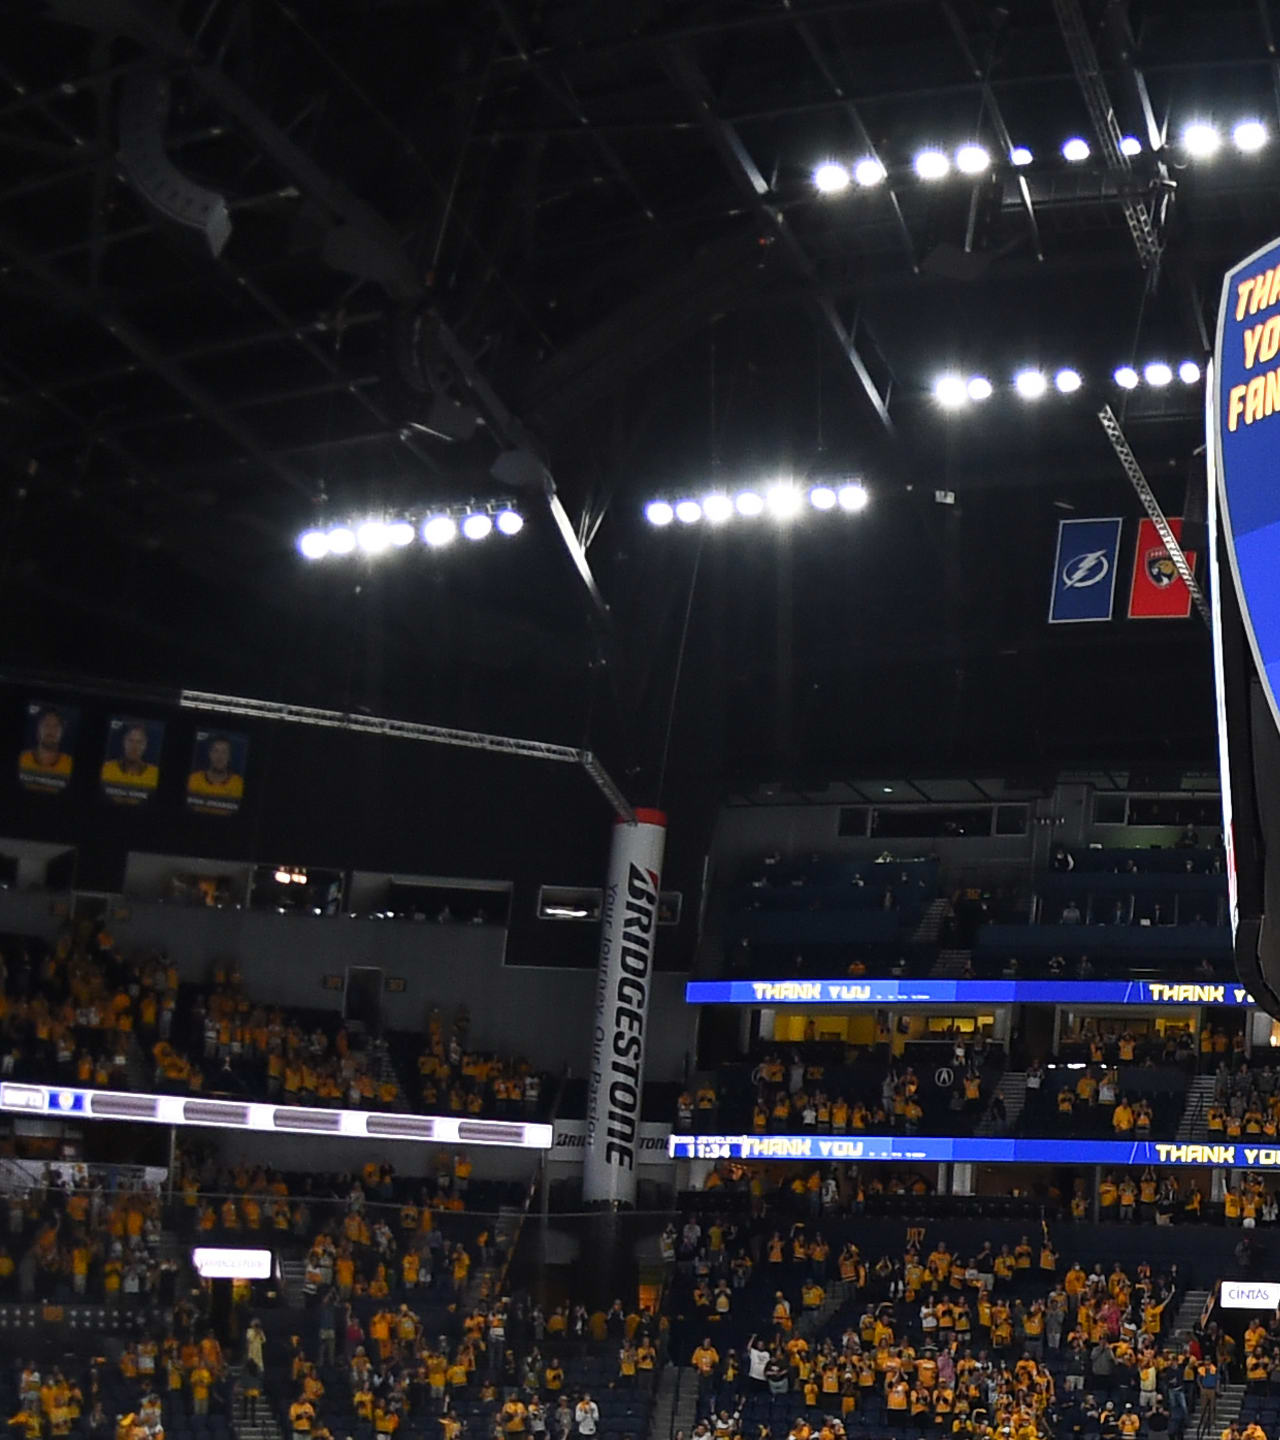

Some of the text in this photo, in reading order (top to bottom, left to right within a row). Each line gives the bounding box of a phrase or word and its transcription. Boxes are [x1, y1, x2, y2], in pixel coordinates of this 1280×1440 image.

[753, 983, 871, 1000] THANK YOU
[1149, 983, 1224, 1003] THANK
[605, 862, 660, 1171] BRIDGESTONE
[687, 1143, 731, 1158] 11:34
[746, 1137, 864, 1157] THANK YOU
[1156, 1144, 1235, 1165] THANK
[1228, 1287, 1270, 1302] CINTAS
